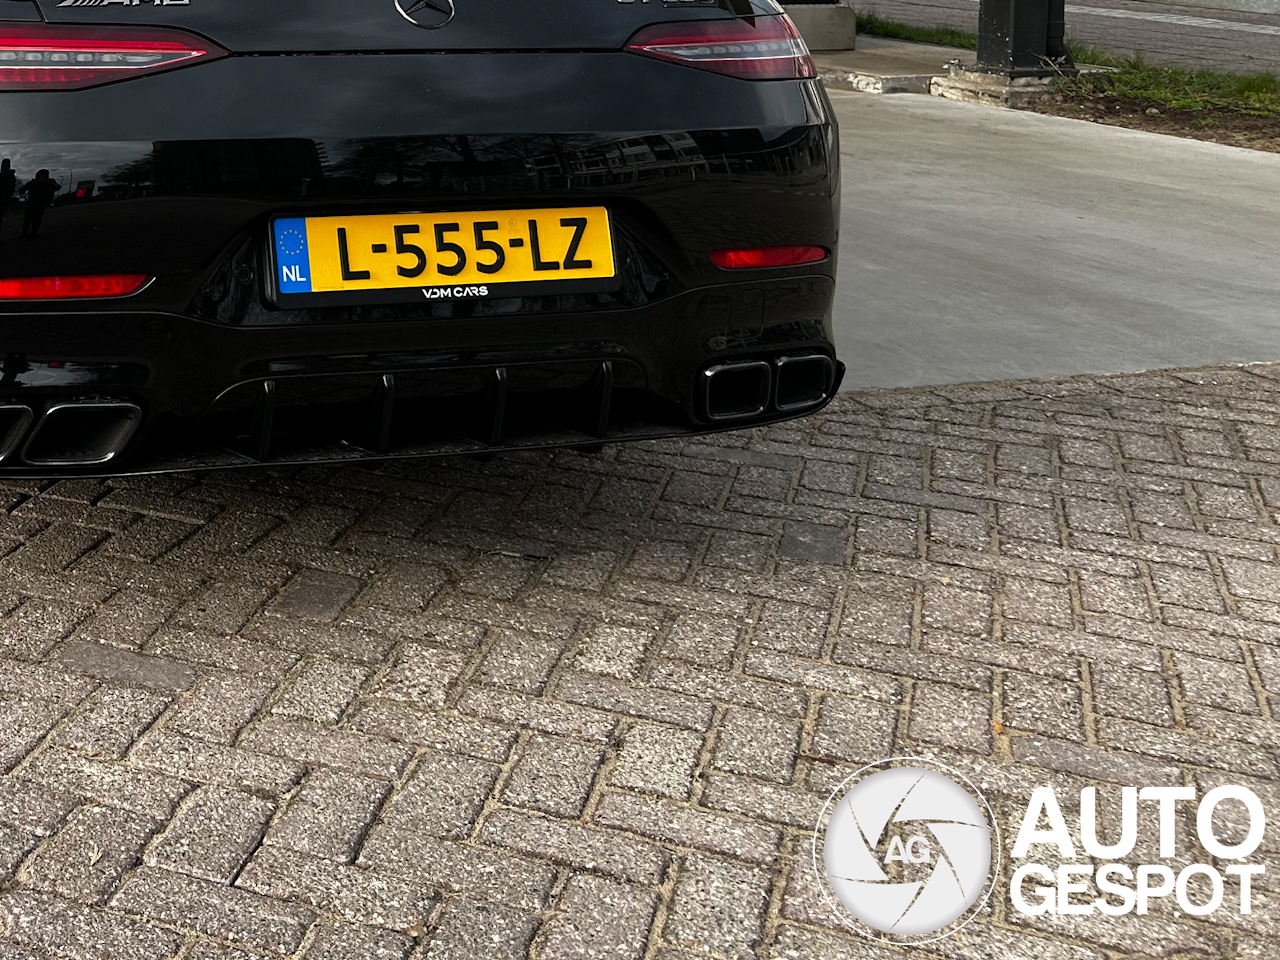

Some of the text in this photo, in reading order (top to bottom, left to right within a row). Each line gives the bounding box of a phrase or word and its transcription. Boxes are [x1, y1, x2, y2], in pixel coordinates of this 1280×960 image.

[336, 217, 593, 282] L-555-LZ
[282, 265, 306, 282] NL
[422, 285, 489, 299] VDM CARS
